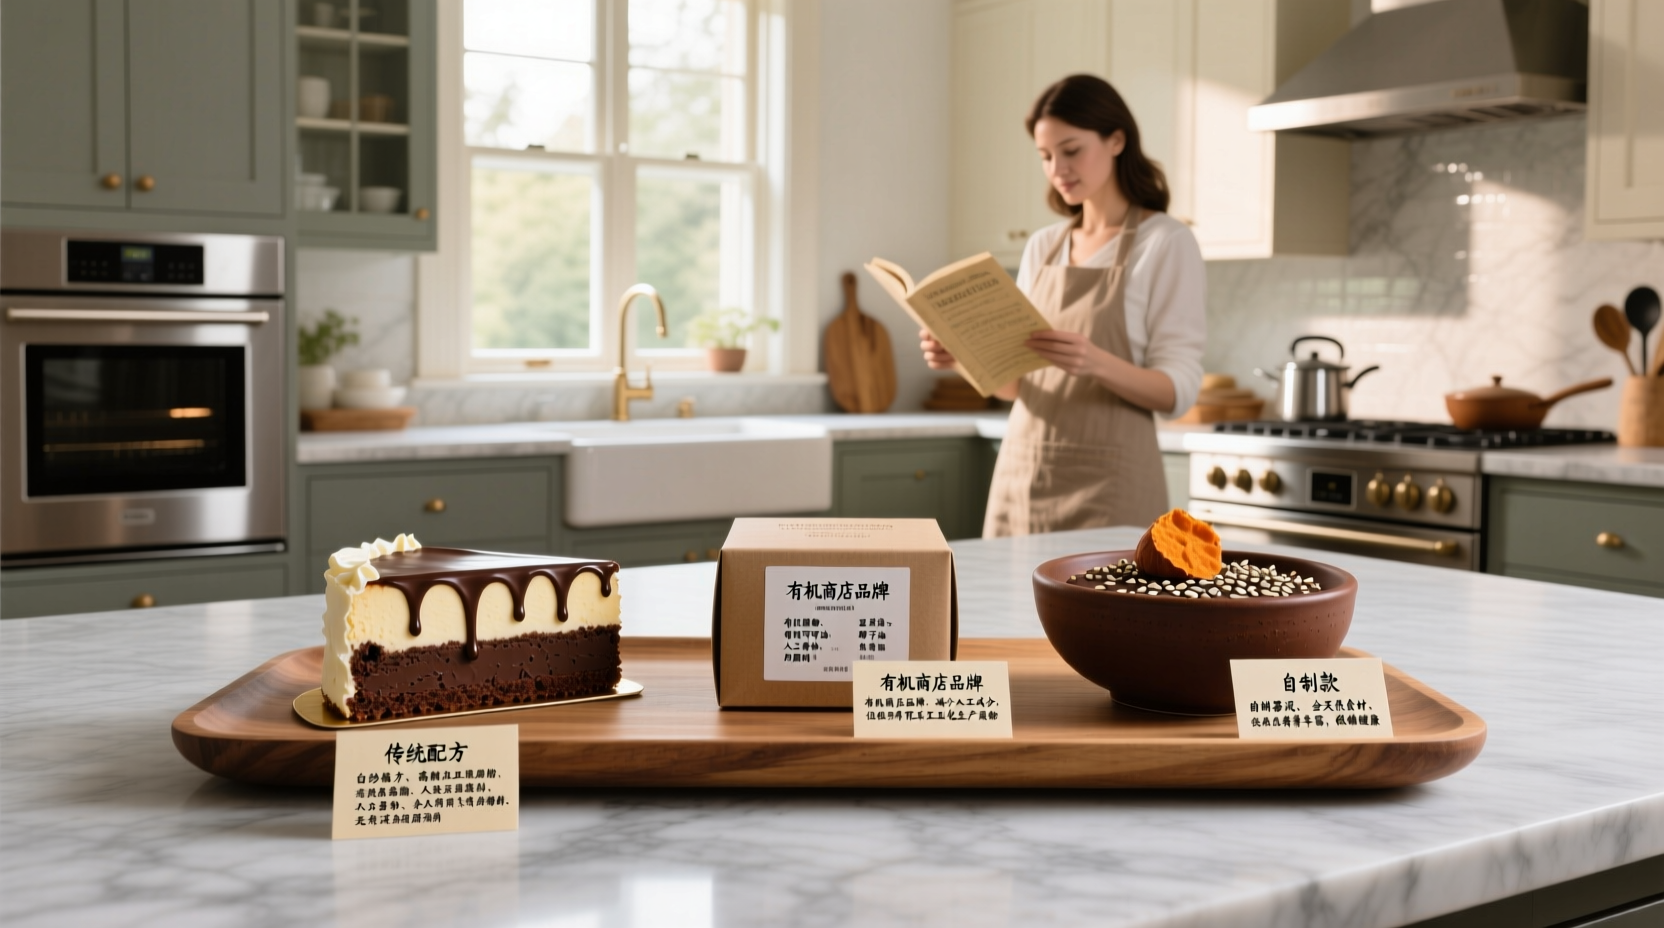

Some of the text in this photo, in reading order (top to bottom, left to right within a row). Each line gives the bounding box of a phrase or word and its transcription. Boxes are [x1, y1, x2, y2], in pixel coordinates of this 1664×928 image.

[786, 581, 890, 601] 有机商店品牌
[880, 673, 984, 692] 有机商店品牌
[1283, 671, 1340, 693] 自制款
[384, 741, 468, 765] 传统配方
